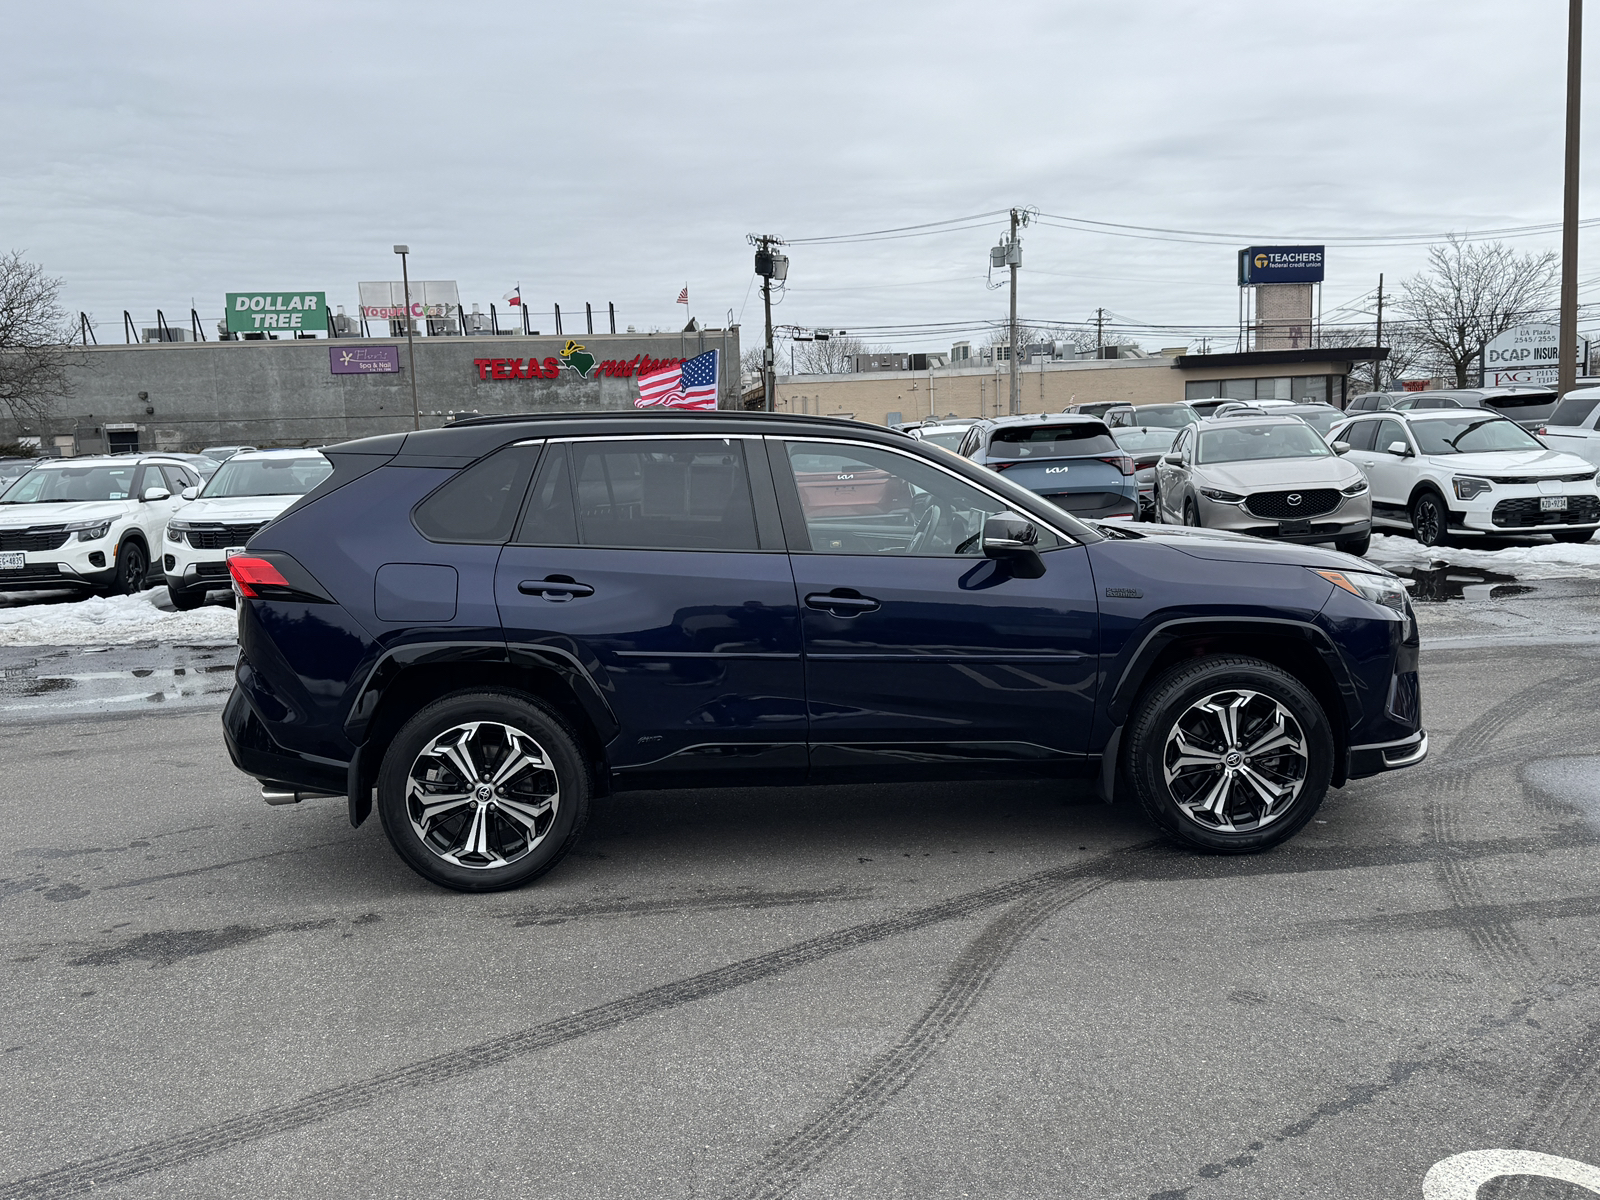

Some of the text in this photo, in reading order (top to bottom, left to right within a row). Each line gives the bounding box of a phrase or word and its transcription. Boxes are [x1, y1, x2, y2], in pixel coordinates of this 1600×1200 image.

[1268, 253, 1322, 262] TEACHERS
[235, 296, 317, 311] DOLLAR
[251, 313, 303, 328] TREE
[1489, 348, 1531, 362] DCAP
[474, 356, 561, 380] TEXAS
